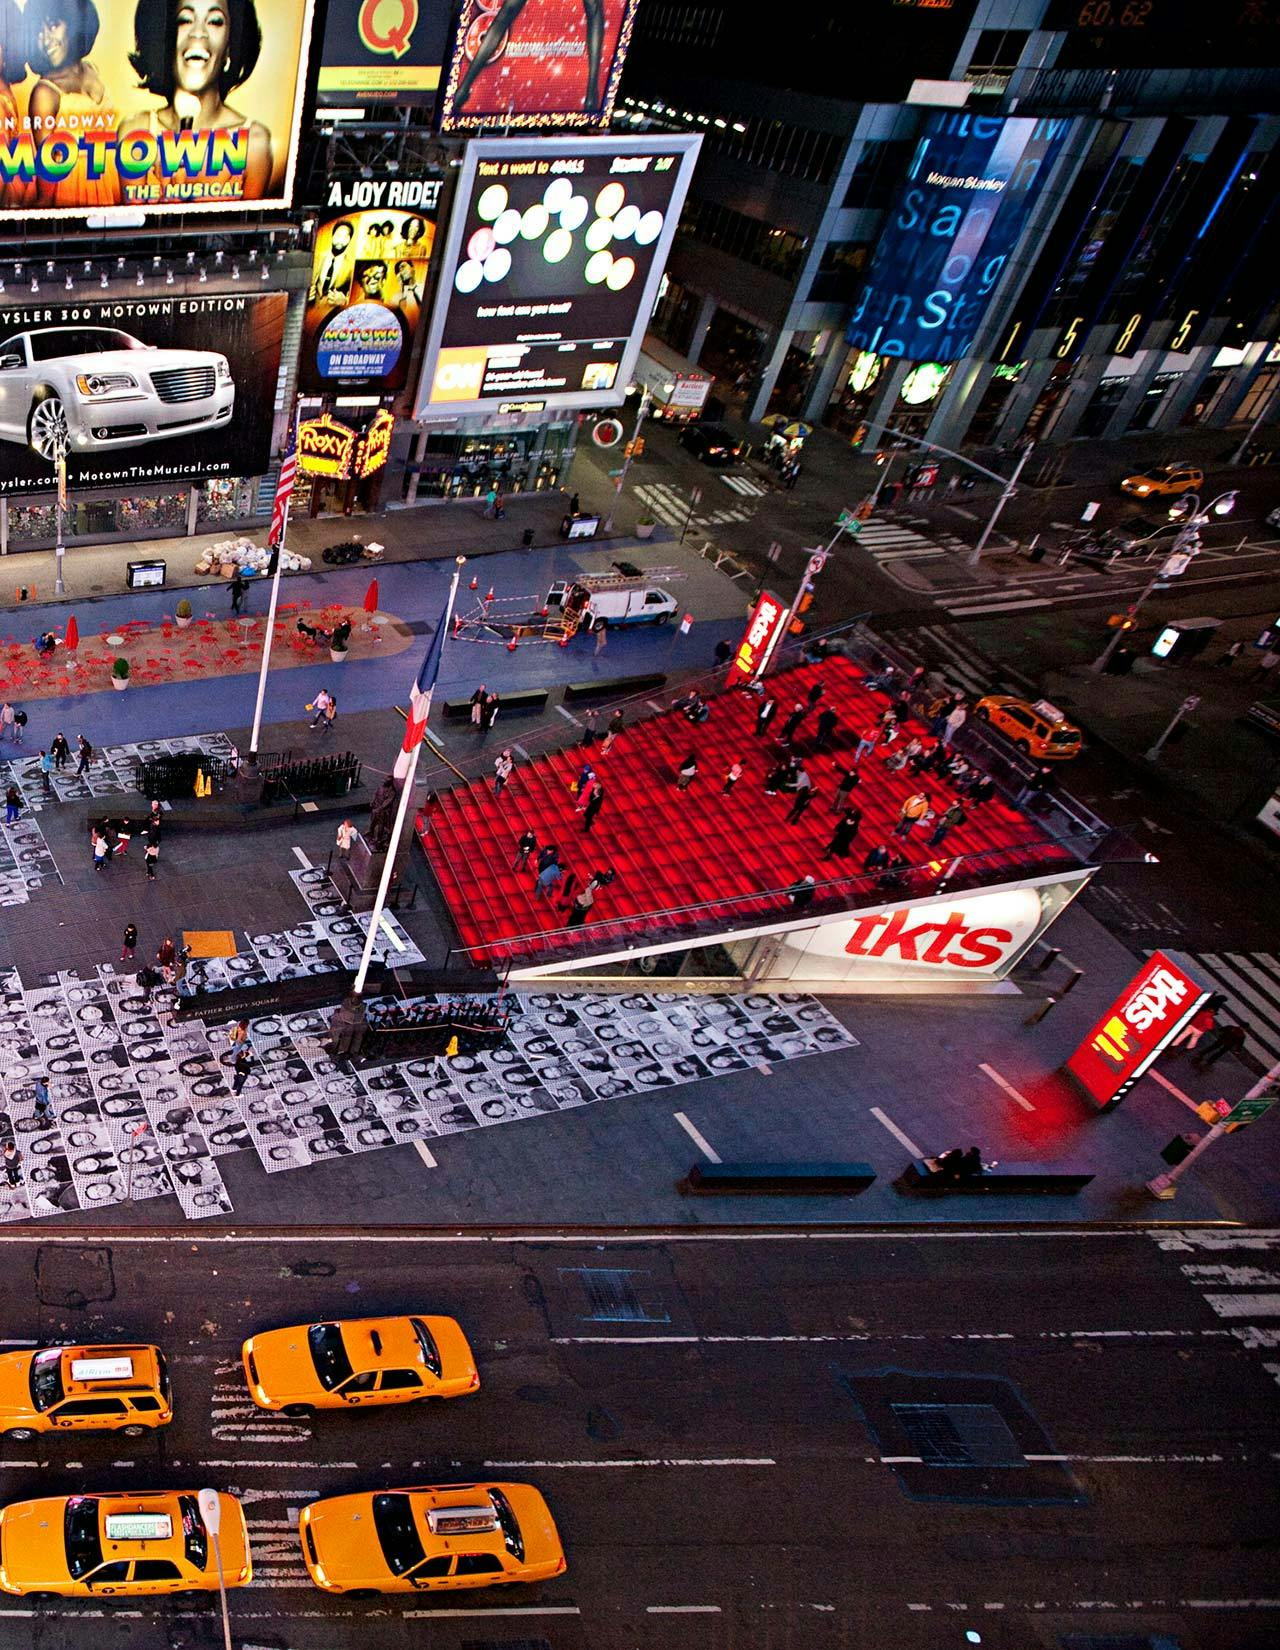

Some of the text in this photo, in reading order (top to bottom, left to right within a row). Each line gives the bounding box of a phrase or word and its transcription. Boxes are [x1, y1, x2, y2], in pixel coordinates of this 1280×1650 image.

[22, 114, 116, 130] BROADWAY
[126, 182, 244, 199] THE MUSICAL
[925, 172, 1007, 193] Morgan Stanley
[344, 181, 387, 207] JOY
[61, 309, 91, 320] 300
[101, 303, 171, 318] MOTOWN
[179, 299, 246, 314] EDITION
[322, 328, 399, 341] MOTOWN
[329, 354, 386, 365] ON BROADWAY
[79, 461, 231, 482] MotownTheMusical.com
[844, 909, 1013, 968] tkts
[194, 998, 280, 1016] FATHER DUFFY SQUARE
[1125, 969, 1188, 1031] tkts
